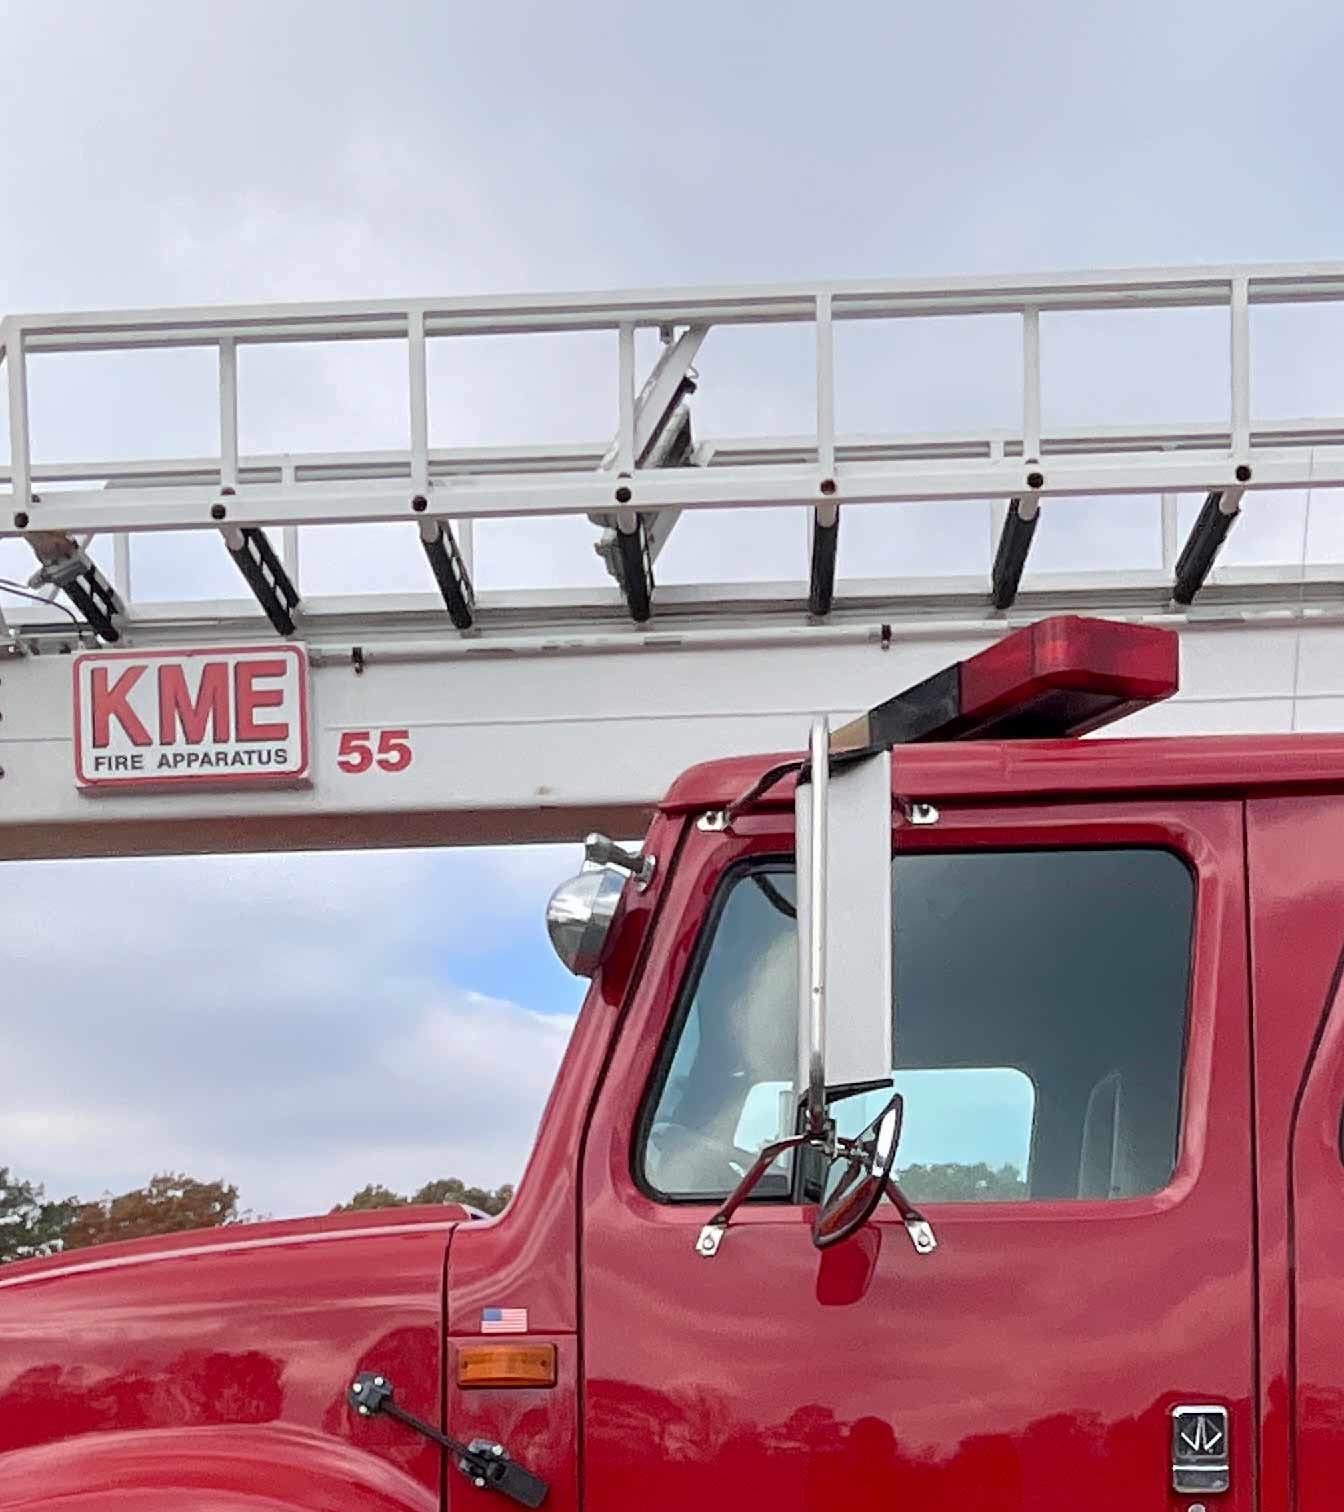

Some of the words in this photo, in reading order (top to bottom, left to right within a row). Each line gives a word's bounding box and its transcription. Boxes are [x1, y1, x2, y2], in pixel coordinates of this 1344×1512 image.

[90, 658, 290, 749] KME
[94, 753, 144, 771] FIRE
[157, 749, 288, 769] APPARATUS
[337, 729, 413, 774] 55
